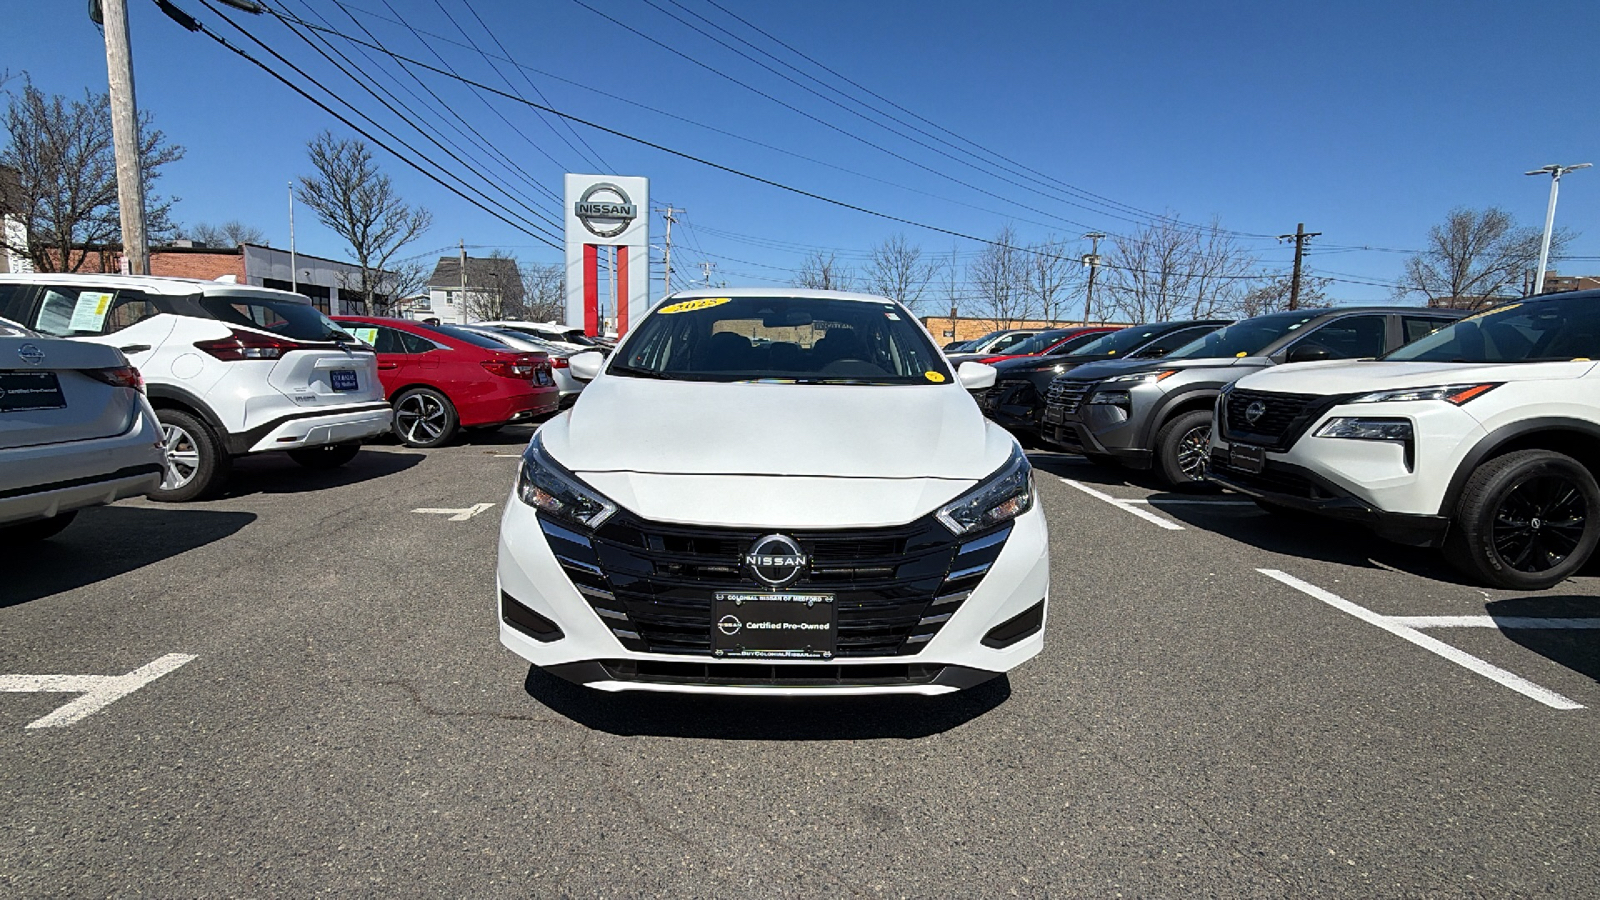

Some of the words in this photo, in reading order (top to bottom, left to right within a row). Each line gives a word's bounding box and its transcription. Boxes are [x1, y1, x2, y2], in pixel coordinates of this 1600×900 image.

[580, 204, 631, 215] NISSAN
[746, 556, 806, 566] NISSAN
[746, 621, 781, 629] Certified
[783, 622, 830, 630] Pre-Owned
